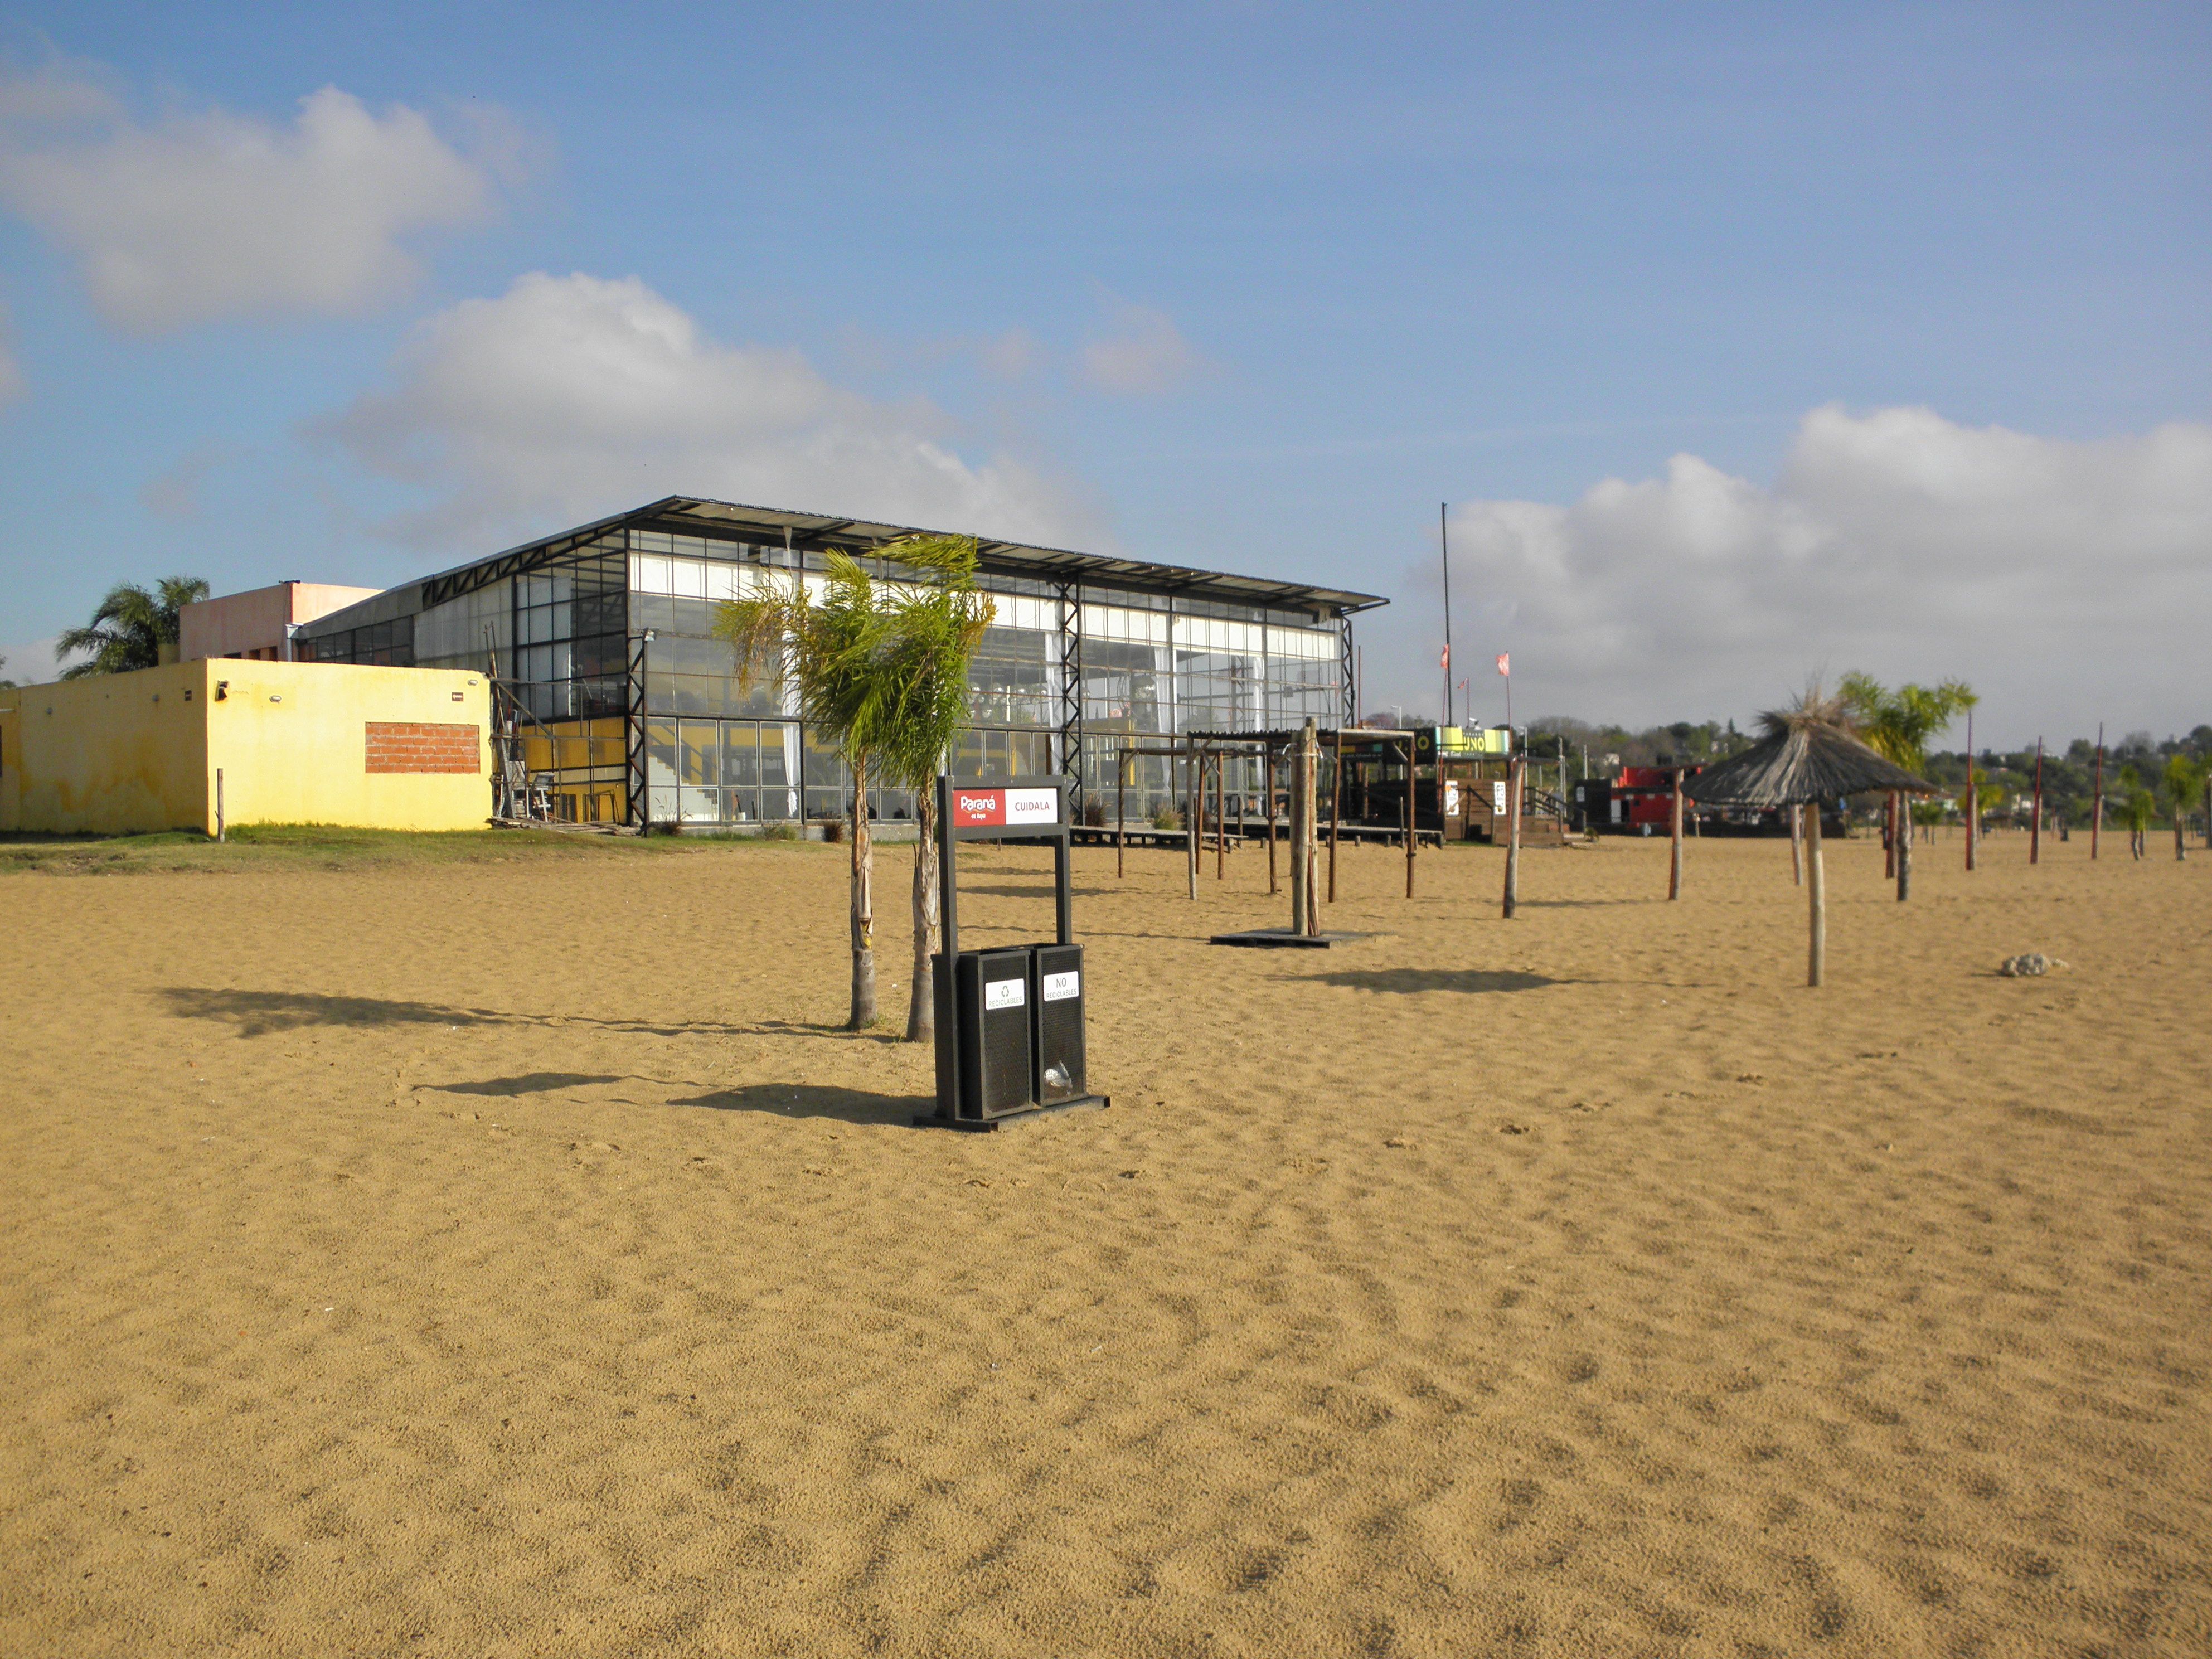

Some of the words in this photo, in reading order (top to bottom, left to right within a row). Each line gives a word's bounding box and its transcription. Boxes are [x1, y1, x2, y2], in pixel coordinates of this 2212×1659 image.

[961, 795, 996, 811] Paraná
[1015, 802, 1050, 811] CUIDALA
[1056, 977, 1067, 988] NO
[1046, 989, 1077, 999] RECICLABLES
[988, 996, 1022, 1007] RECICLABLES
